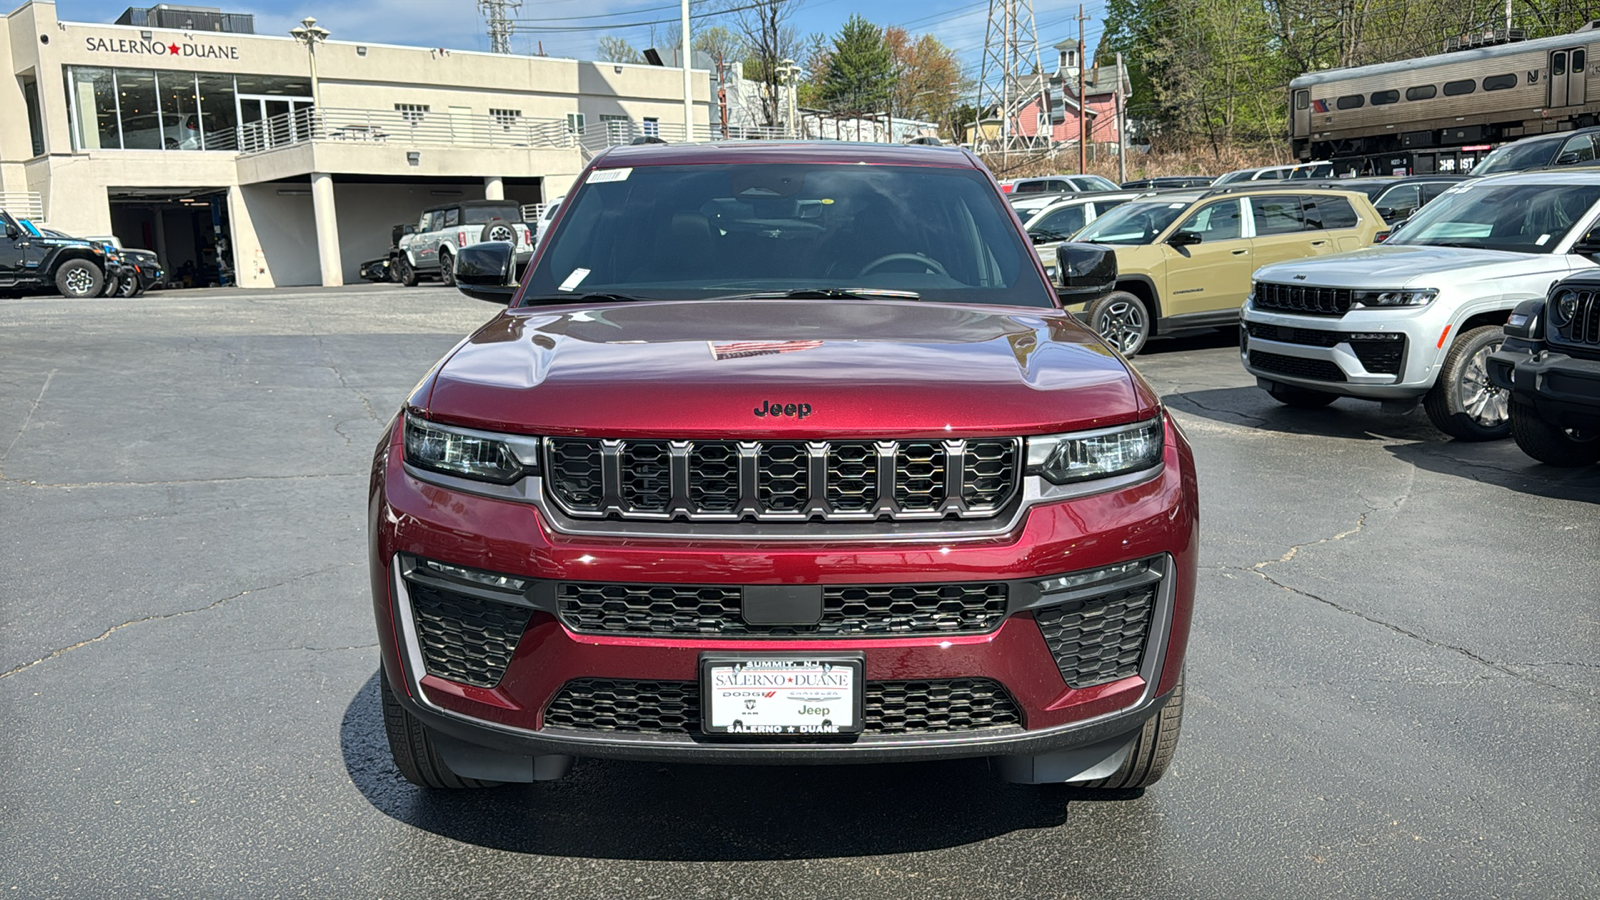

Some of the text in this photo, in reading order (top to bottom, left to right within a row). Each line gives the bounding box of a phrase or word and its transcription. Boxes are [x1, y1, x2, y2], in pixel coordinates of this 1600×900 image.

[86, 37, 239, 60] SALERNO DUANE
[753, 400, 812, 419] Jeep
[715, 674, 849, 687] SALERNO DUANE
[798, 704, 831, 717] Jeep
[726, 725, 840, 734] SALERNO DUANE
